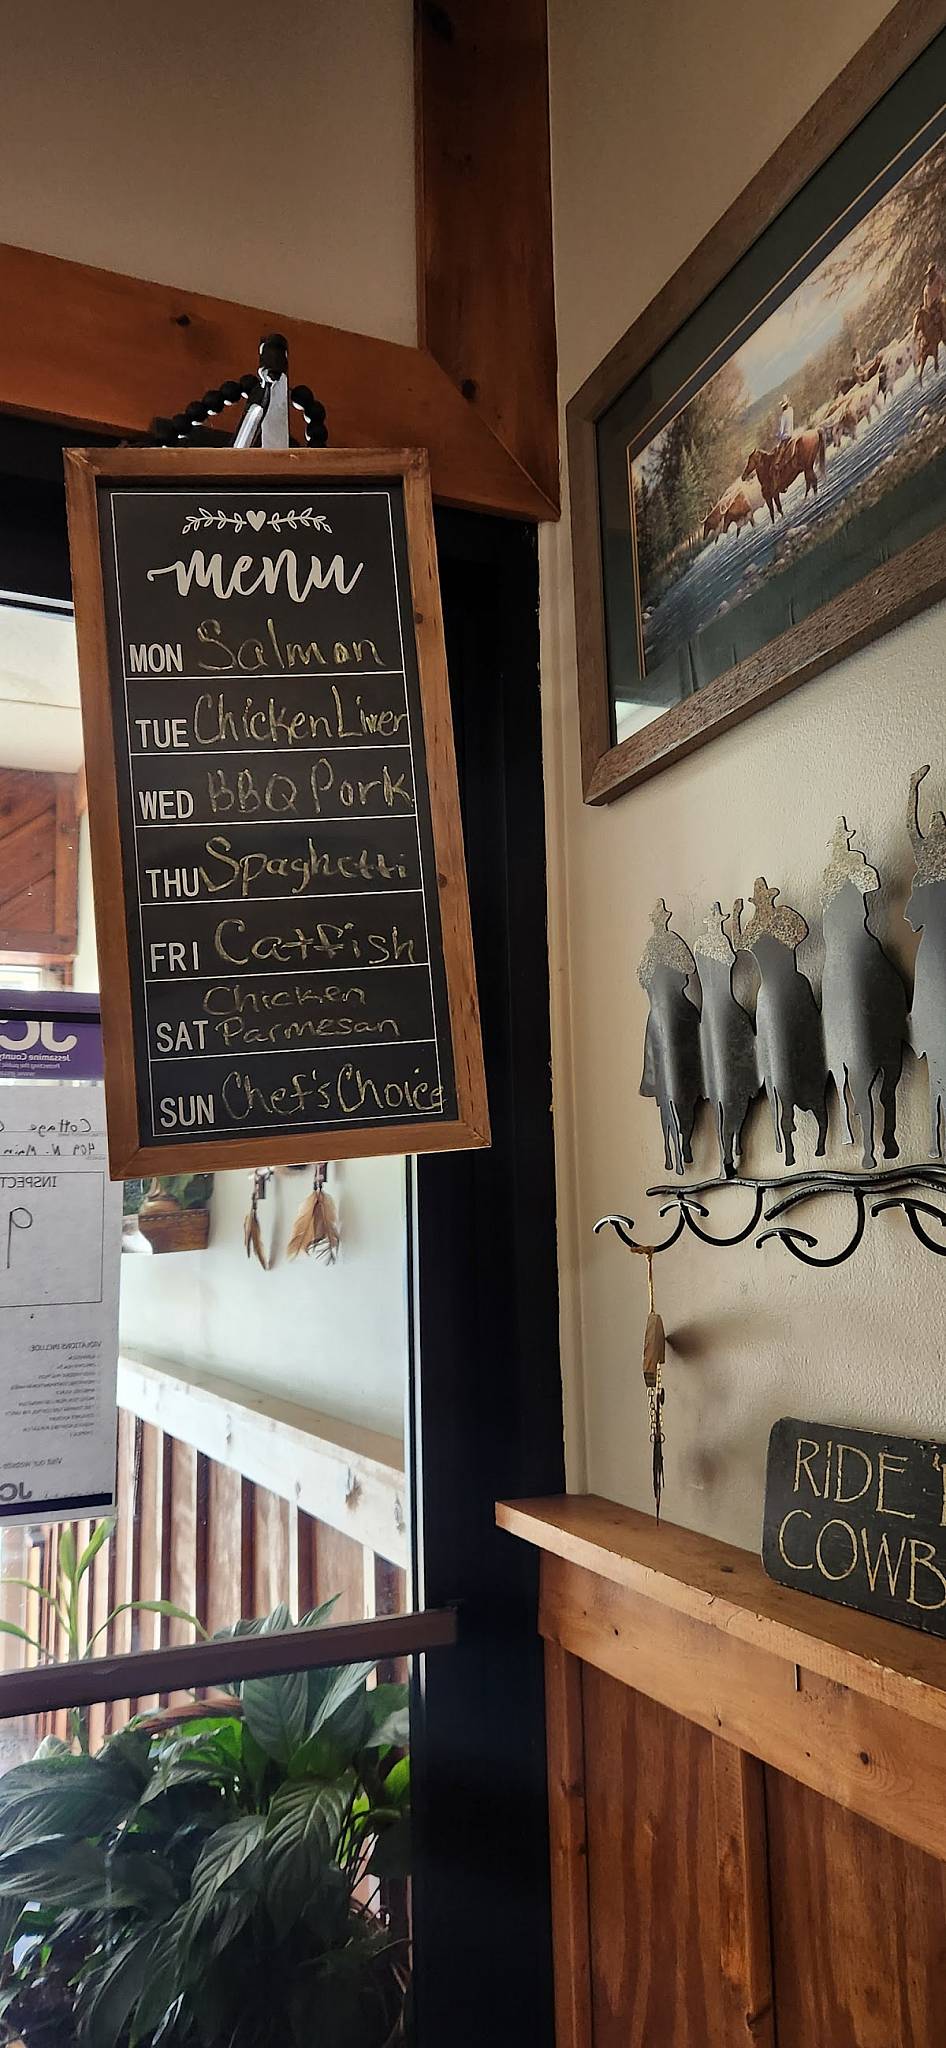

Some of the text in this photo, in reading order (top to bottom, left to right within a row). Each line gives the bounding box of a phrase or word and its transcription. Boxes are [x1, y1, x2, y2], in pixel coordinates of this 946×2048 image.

[147, 549, 364, 603] menu
[129, 618, 387, 673] MON Salmon
[135, 719, 190, 748] TUE
[194, 693, 332, 745] Chicken
[138, 758, 415, 820] WED BBQ Pork
[145, 836, 407, 898] THU Spaghetti
[150, 941, 199, 973] FRI
[203, 984, 367, 1016] Chicken
[156, 1016, 402, 1053] SAT Parmesan
[160, 1063, 447, 1128] SUN Chef's Choice
[793, 1438, 916, 1519] RIDE
